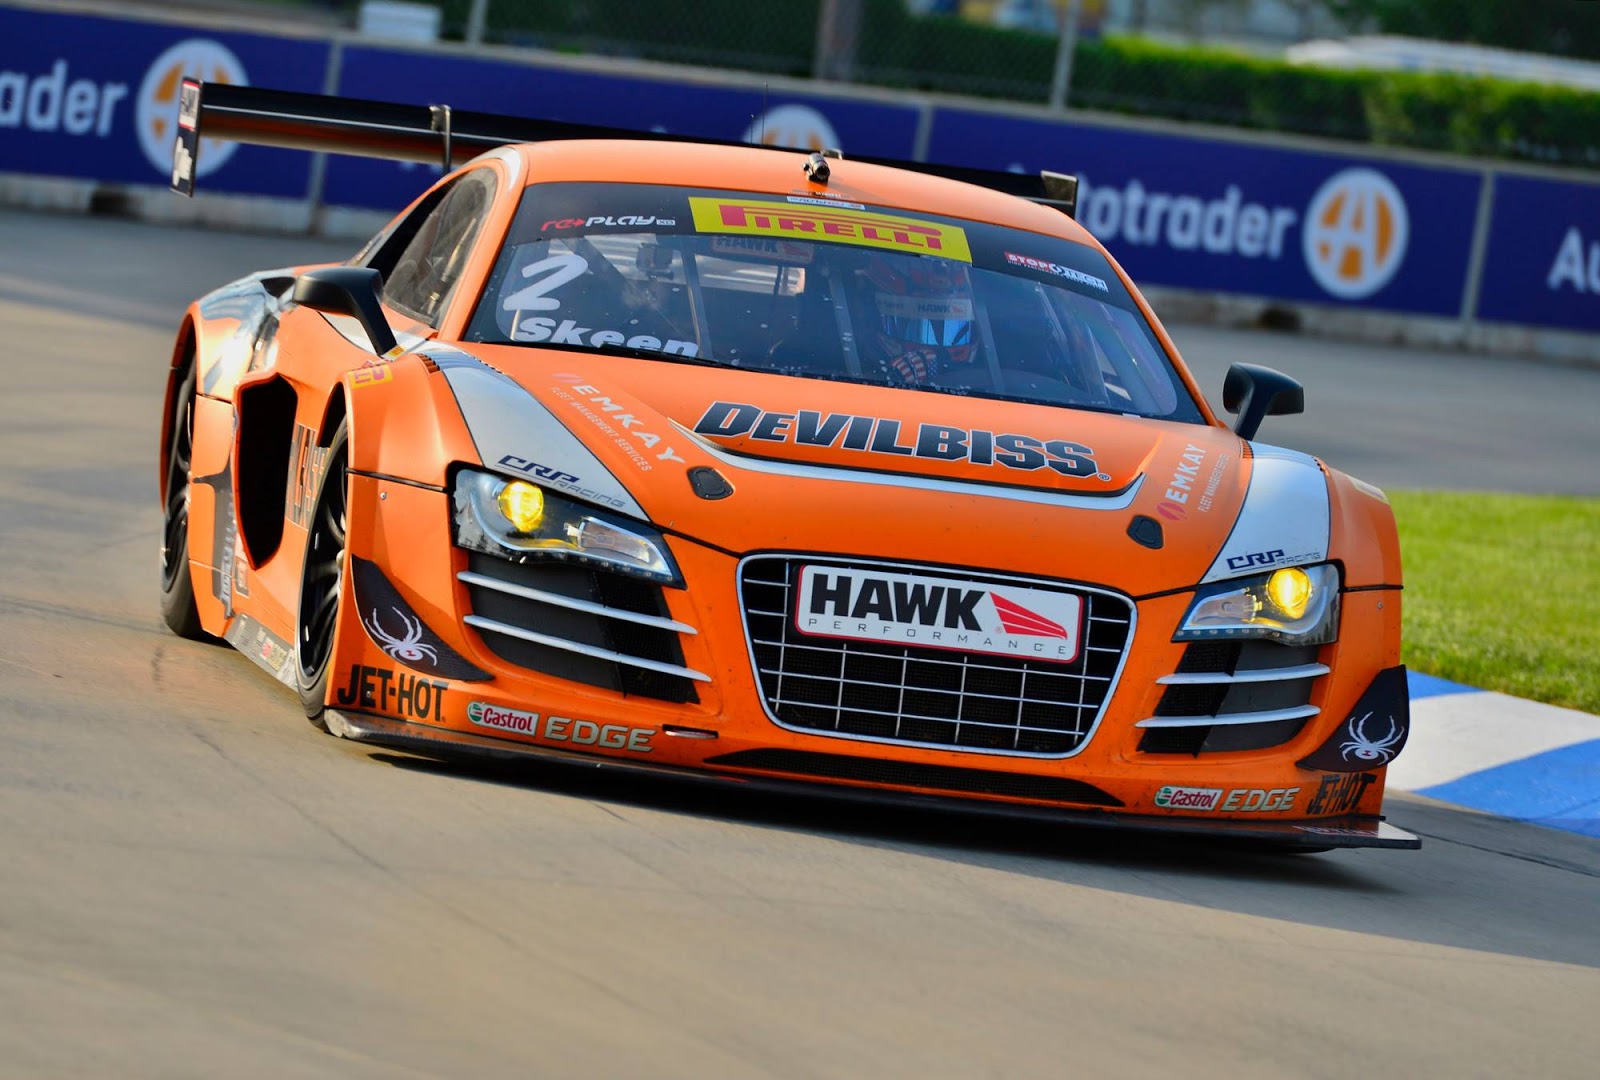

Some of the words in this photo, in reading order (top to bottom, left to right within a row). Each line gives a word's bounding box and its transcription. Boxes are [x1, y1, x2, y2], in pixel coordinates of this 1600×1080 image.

[719, 204, 942, 250] PIRELLI
[1076, 170, 1297, 260] totrader
[502, 254, 589, 311] 2
[918, 303, 951, 313] HAWK
[515, 317, 699, 357] Skeen
[570, 401, 619, 441] MANAGEMENT
[615, 438, 652, 472] SERVICES
[571, 384, 686, 464] EMKAY
[498, 455, 580, 483] CRP
[1165, 443, 1206, 504] EMKAY
[1227, 549, 1285, 570] CRP
[810, 573, 986, 632] HAWK
[808, 618, 1067, 655] PERFORMANCE
[337, 664, 449, 722] JET-HOT
[483, 707, 533, 733] Castrol
[545, 716, 657, 752] EDGE
[1170, 790, 1217, 808] Castrol
[1221, 787, 1301, 813] EDGE
[1306, 773, 1377, 815] JET-HOT
